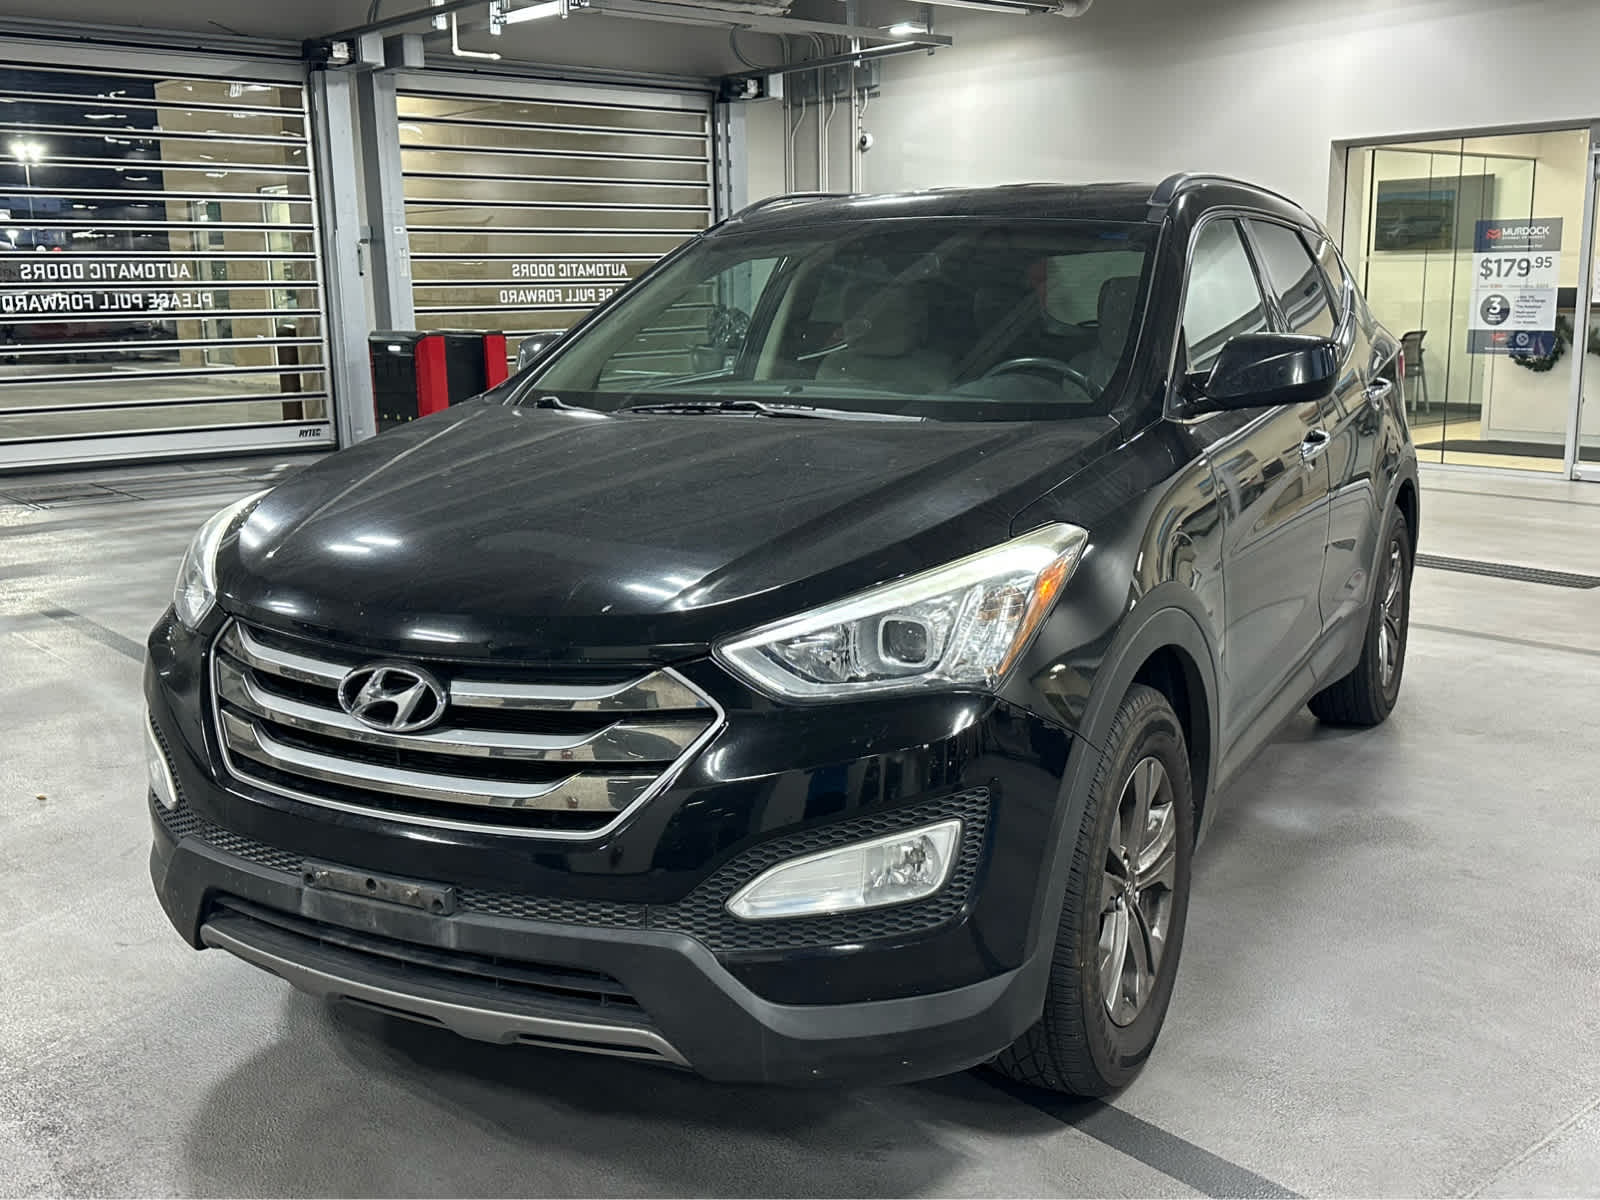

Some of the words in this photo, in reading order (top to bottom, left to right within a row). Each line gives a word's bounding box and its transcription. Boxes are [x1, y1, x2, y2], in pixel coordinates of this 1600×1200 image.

[1502, 226, 1550, 236] MURDOCK
[1480, 256, 1552, 280] $179.95
[1489, 297, 1501, 313] 3
[299, 428, 321, 438] RYTEC
